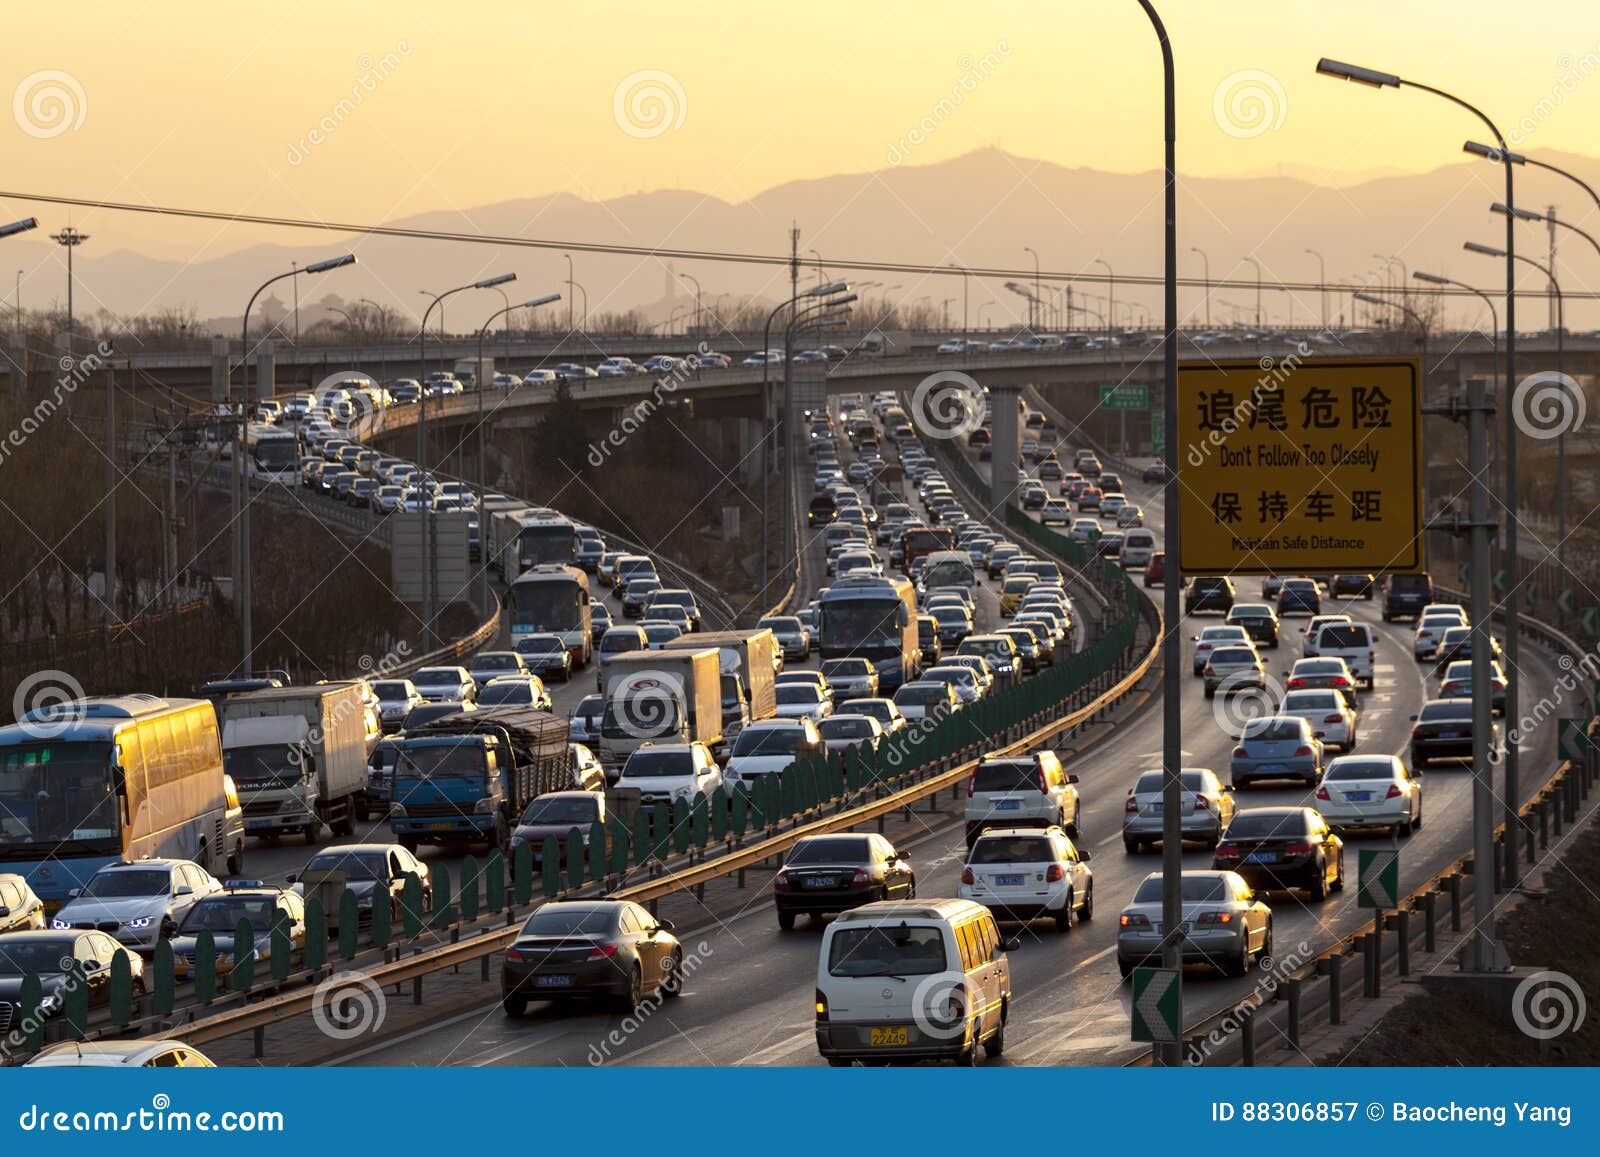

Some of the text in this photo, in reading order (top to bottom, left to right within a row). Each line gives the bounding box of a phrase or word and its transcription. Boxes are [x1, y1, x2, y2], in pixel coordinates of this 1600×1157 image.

[1197, 386, 1392, 431] 追尾危险
[1220, 443, 1379, 472] Don't Follow Too Closely
[1211, 491, 1382, 524] 保持车距
[1231, 535, 1365, 551] Maintain Safe Distance
[873, 1034, 906, 1046] 22449
